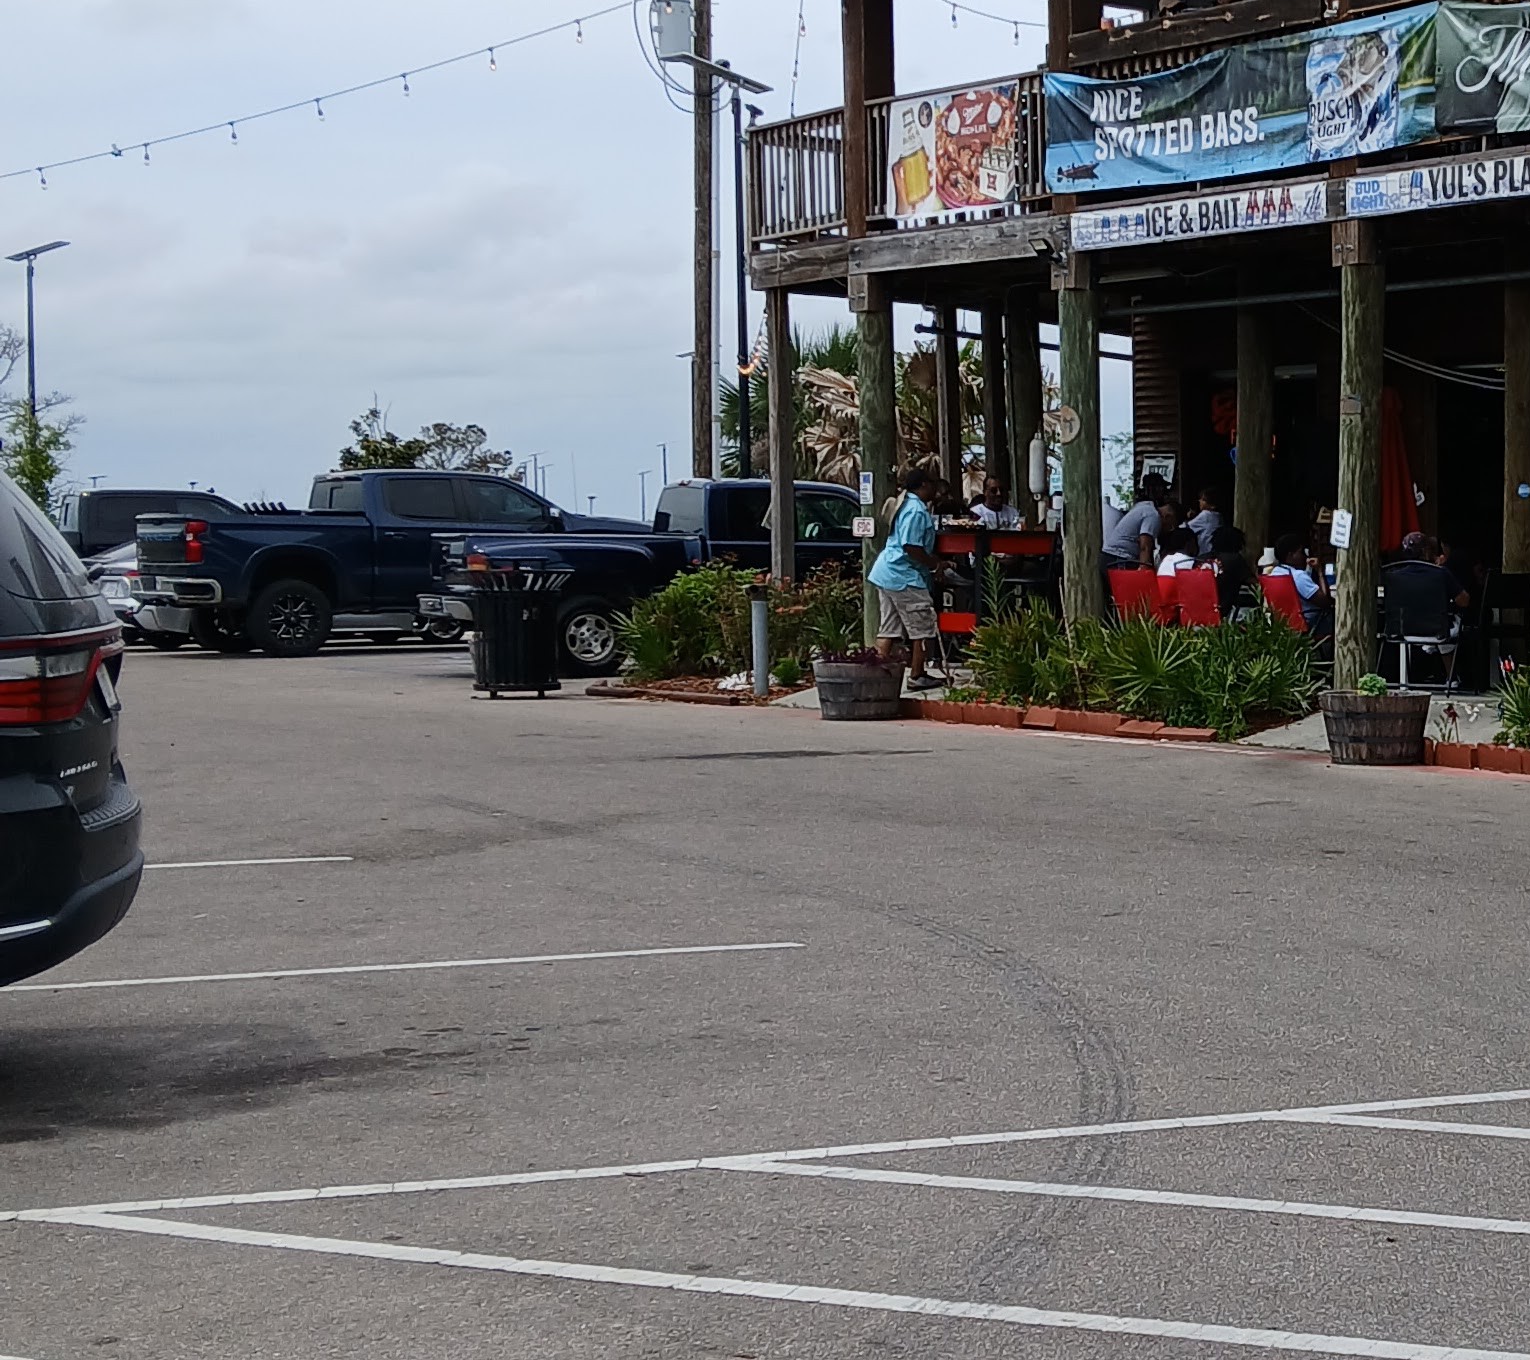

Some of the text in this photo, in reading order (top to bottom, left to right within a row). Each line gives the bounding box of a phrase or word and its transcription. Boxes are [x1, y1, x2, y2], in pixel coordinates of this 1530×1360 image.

[1090, 86, 1143, 122] NICE
[1309, 96, 1354, 126] BUSCH
[1094, 106, 1265, 161] SPOTTED BASS.
[1317, 122, 1347, 138] LIGHT
[1355, 180, 1380, 195] BUD
[1428, 162, 1487, 201] YUL'S
[1146, 197, 1241, 237] ICE & BAIT
